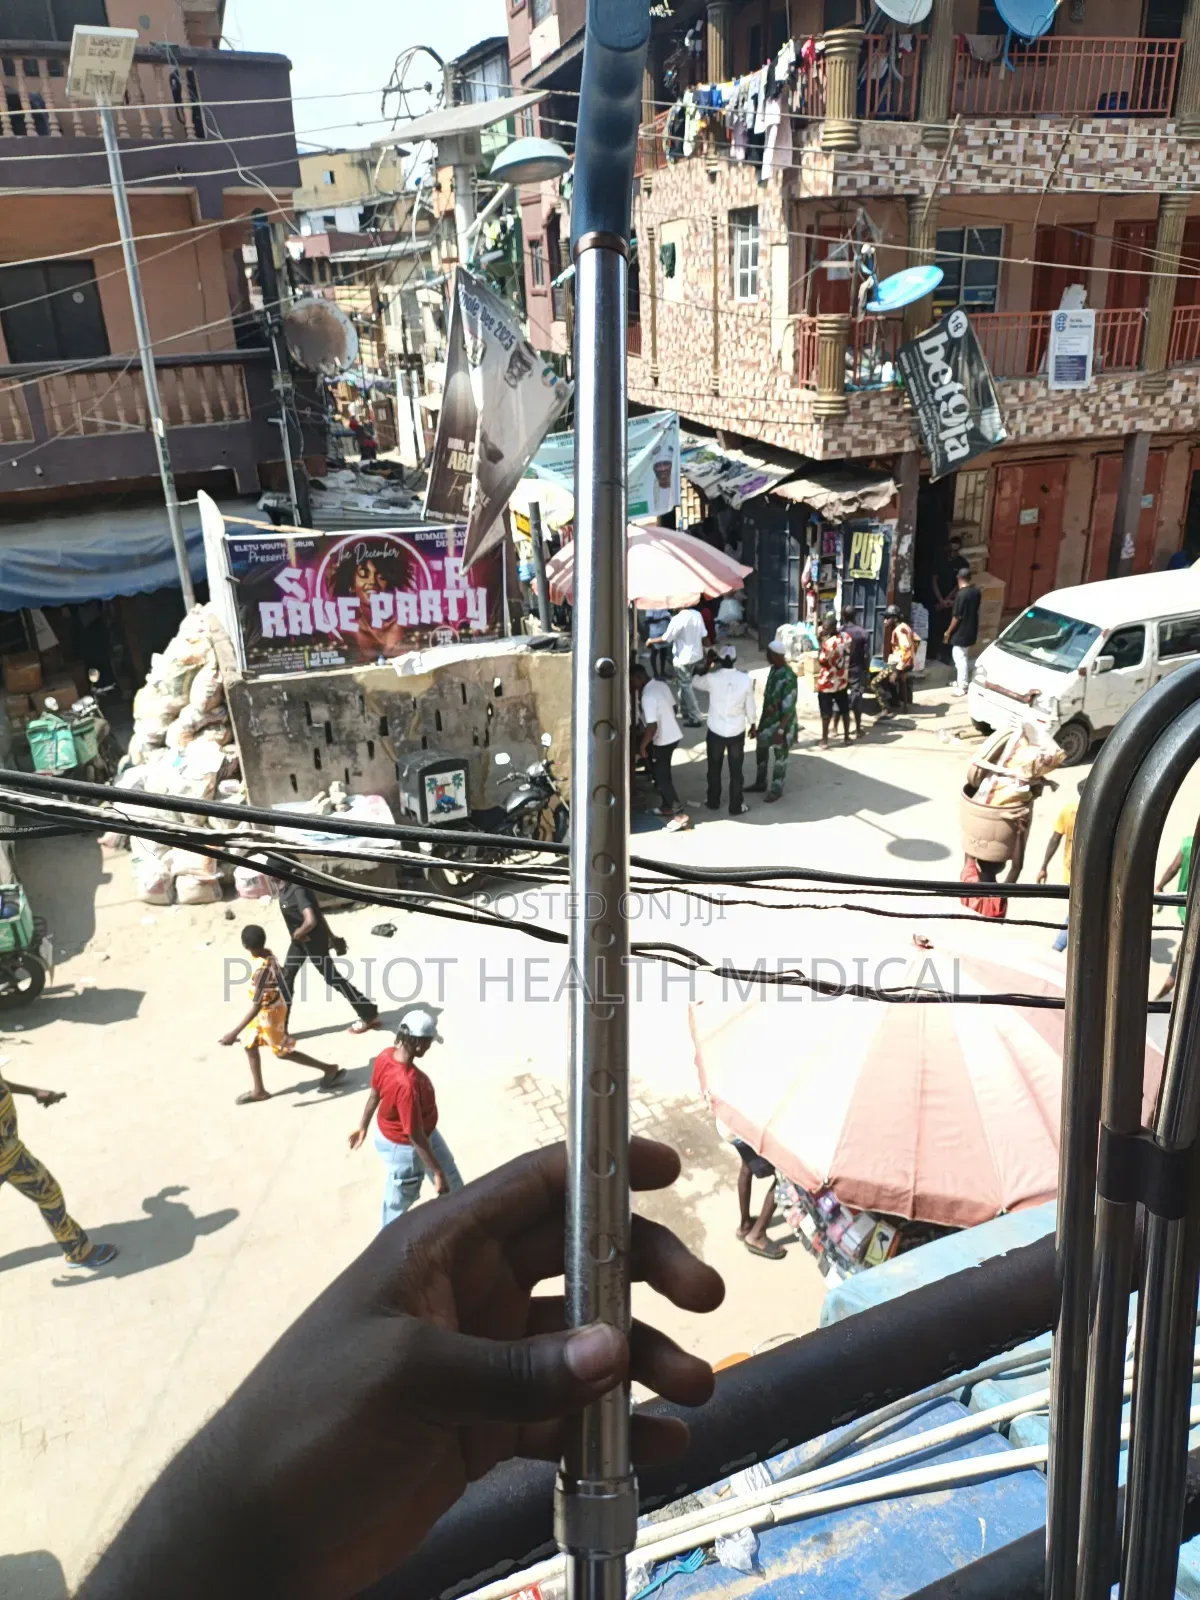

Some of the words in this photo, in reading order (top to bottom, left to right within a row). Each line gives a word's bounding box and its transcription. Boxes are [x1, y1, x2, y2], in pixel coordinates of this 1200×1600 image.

[493, 321, 516, 352] 2025
[259, 541, 287, 551] YOUTH
[354, 542, 400, 565] December
[258, 597, 360, 641] RAVE
[369, 587, 487, 630] PARTY
